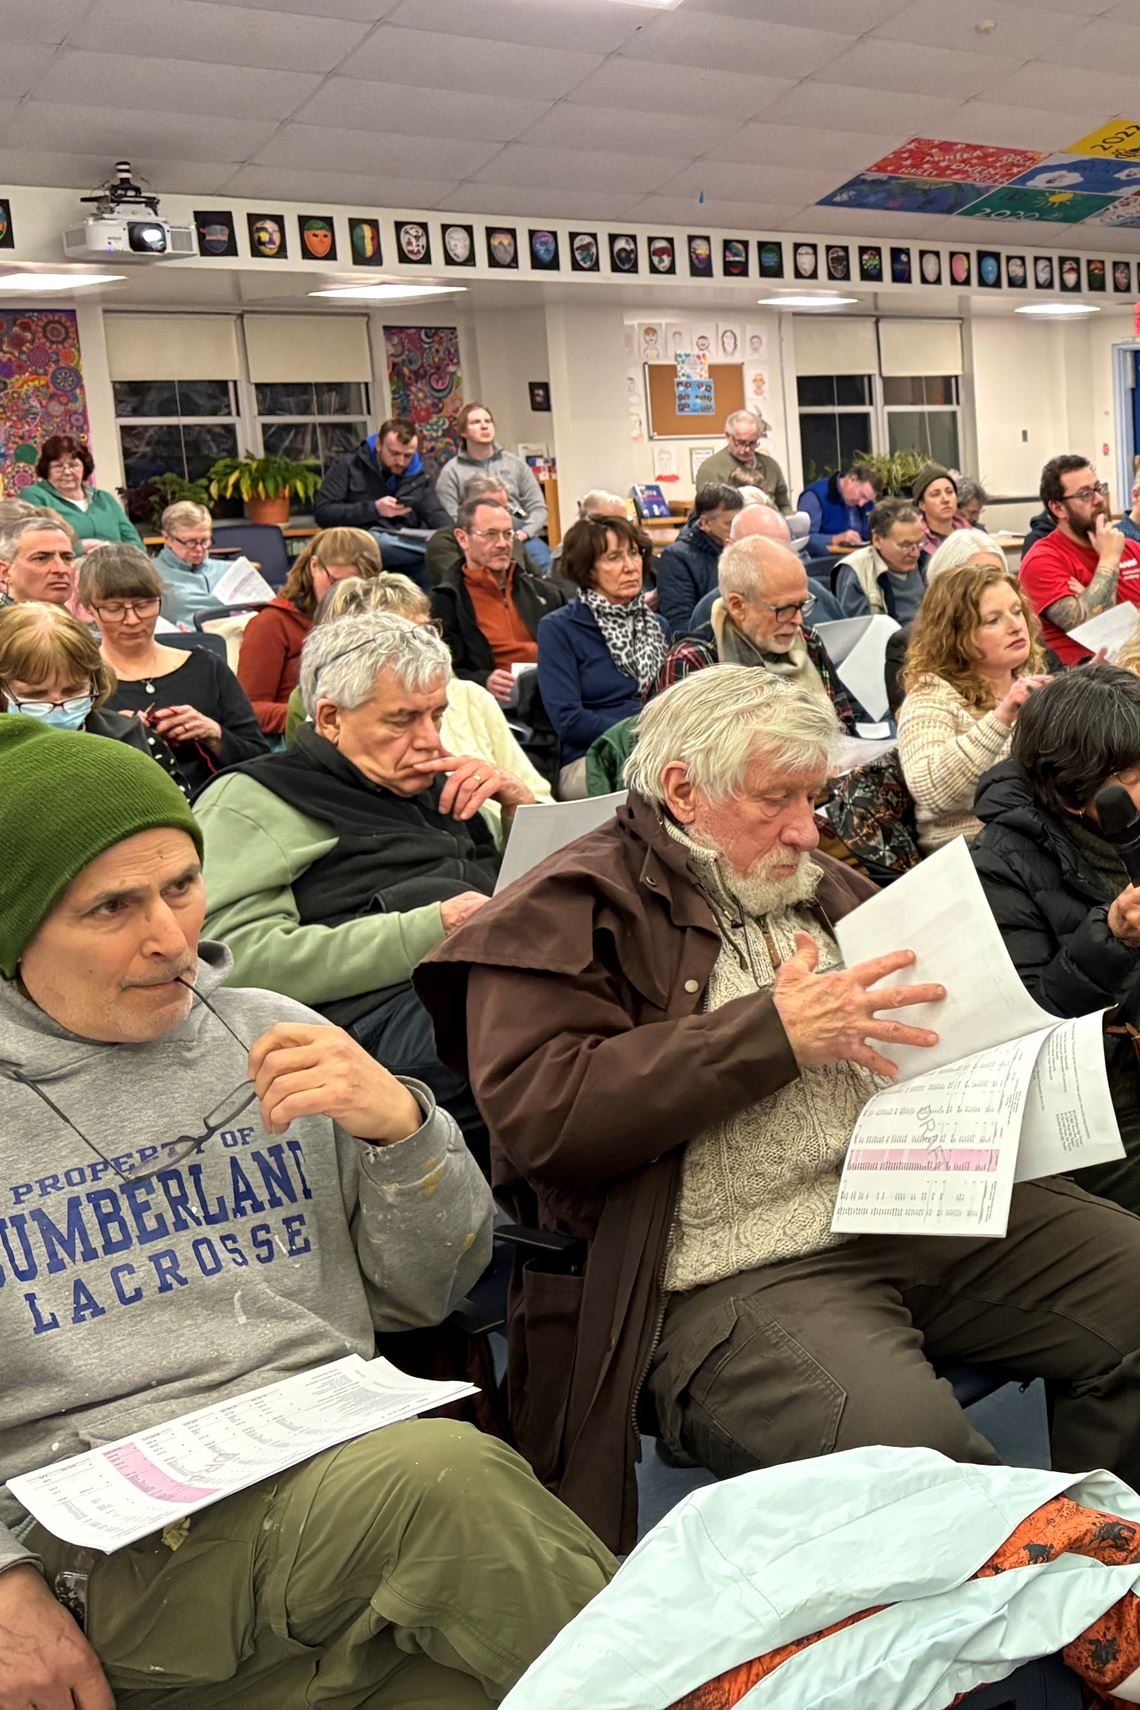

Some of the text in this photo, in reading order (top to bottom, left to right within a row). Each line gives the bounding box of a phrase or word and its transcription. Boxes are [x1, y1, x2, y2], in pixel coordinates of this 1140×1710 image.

[221, 1126, 255, 1148] OF
[0, 1140, 313, 1289] UMBERLAN
[24, 1214, 312, 1335] LACROSSE
